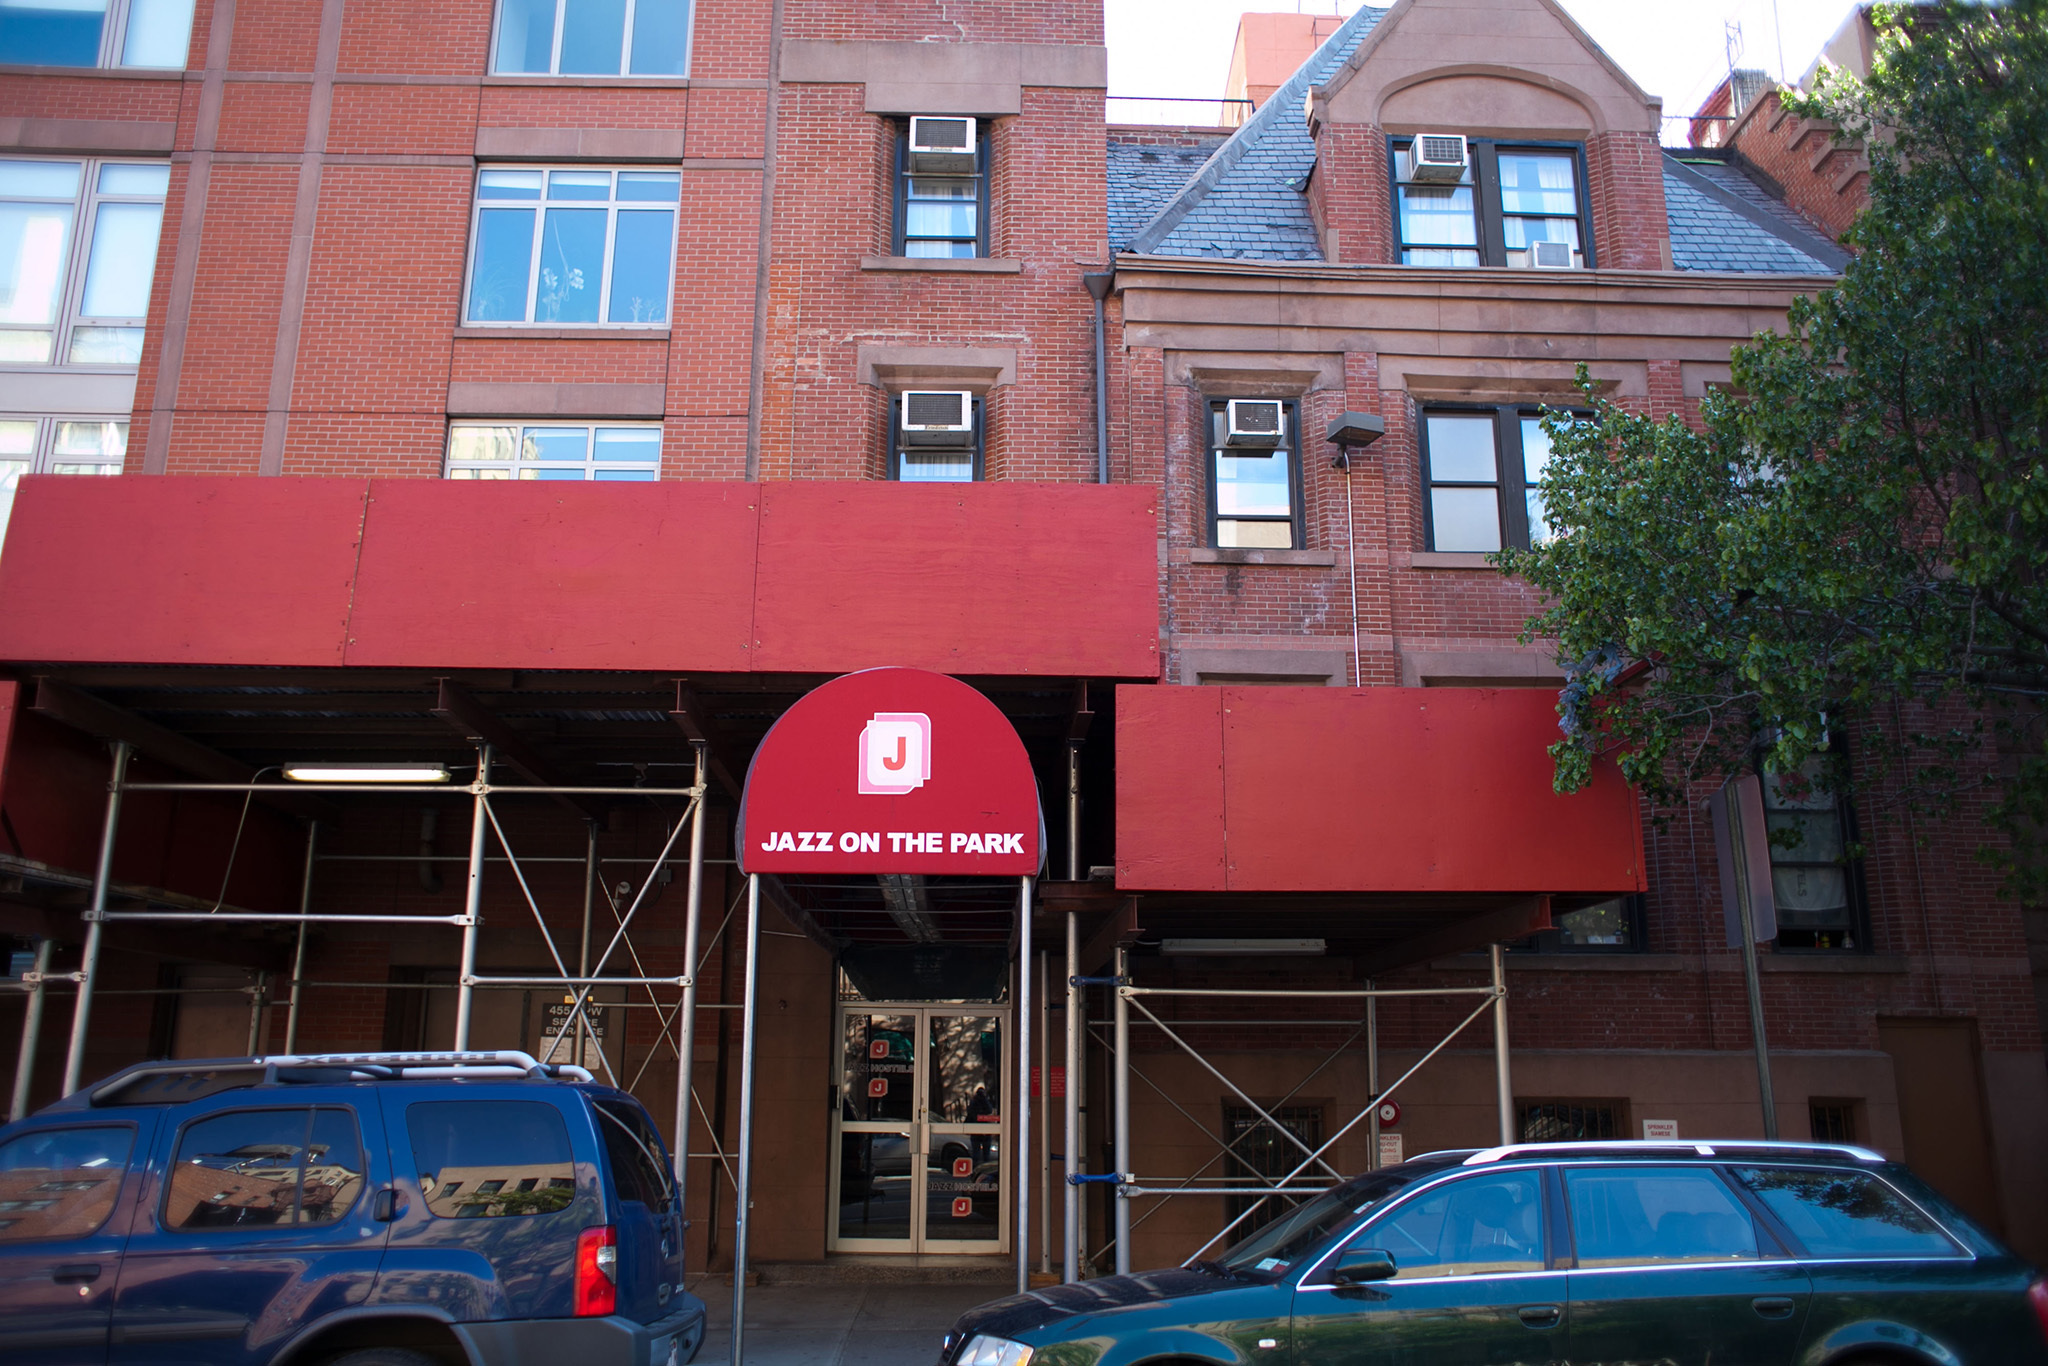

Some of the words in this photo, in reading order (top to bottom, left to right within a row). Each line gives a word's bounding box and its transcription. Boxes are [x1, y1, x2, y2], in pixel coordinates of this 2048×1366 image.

[883, 736, 907, 771] J
[761, 831, 834, 852] JAZZ
[839, 832, 880, 853] ON
[887, 832, 943, 854] THE
[950, 832, 1025, 854] PARK
[1797, 867, 1807, 897] TELS
[549, 1005, 571, 1016] 455
[875, 1044, 884, 1054] J
[874, 1082, 882, 1092] J
[959, 1162, 967, 1172] J
[958, 1201, 966, 1212] J
